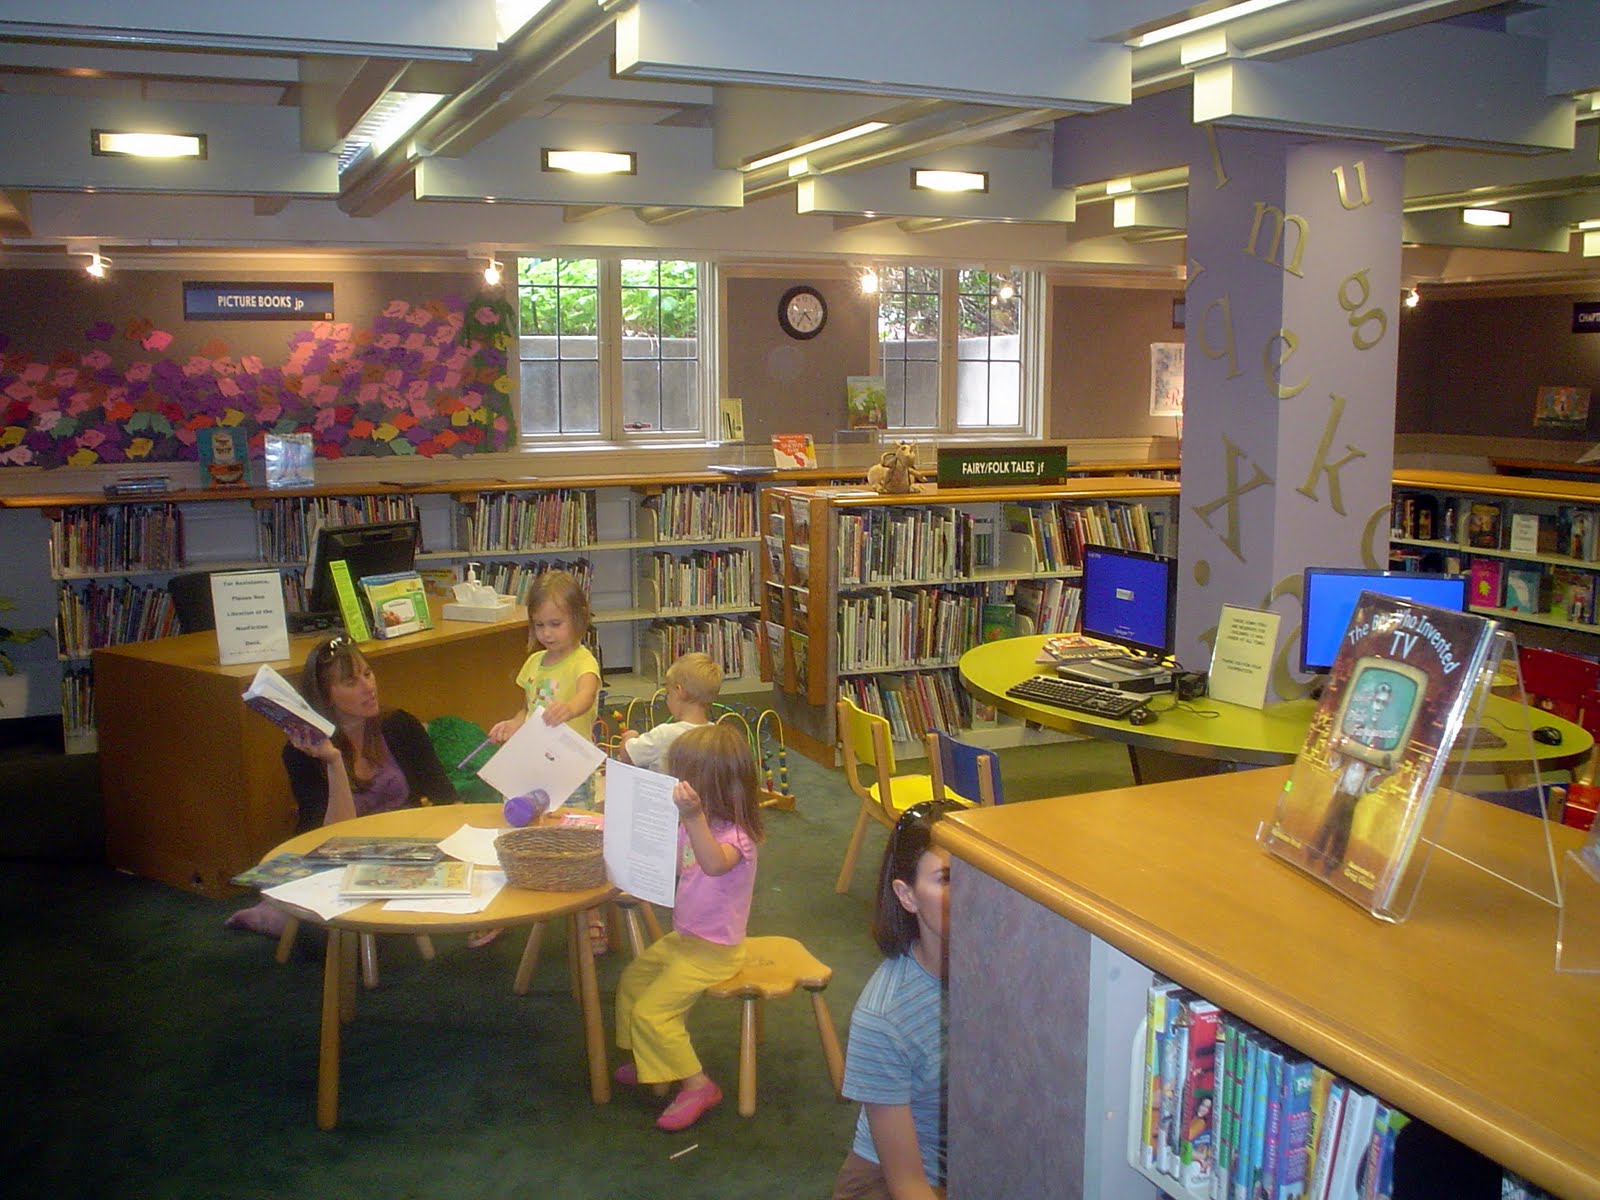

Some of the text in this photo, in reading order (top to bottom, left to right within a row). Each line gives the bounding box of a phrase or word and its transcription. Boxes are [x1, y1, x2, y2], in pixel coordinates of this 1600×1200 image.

[217, 295, 305, 311] PICTURE BOOKS jp
[962, 461, 1045, 475] FAIRY/FOLK TALES jf
[1348, 623, 1369, 645] The
[1416, 615, 1461, 675] Invented
[1389, 630, 1419, 659] TV
